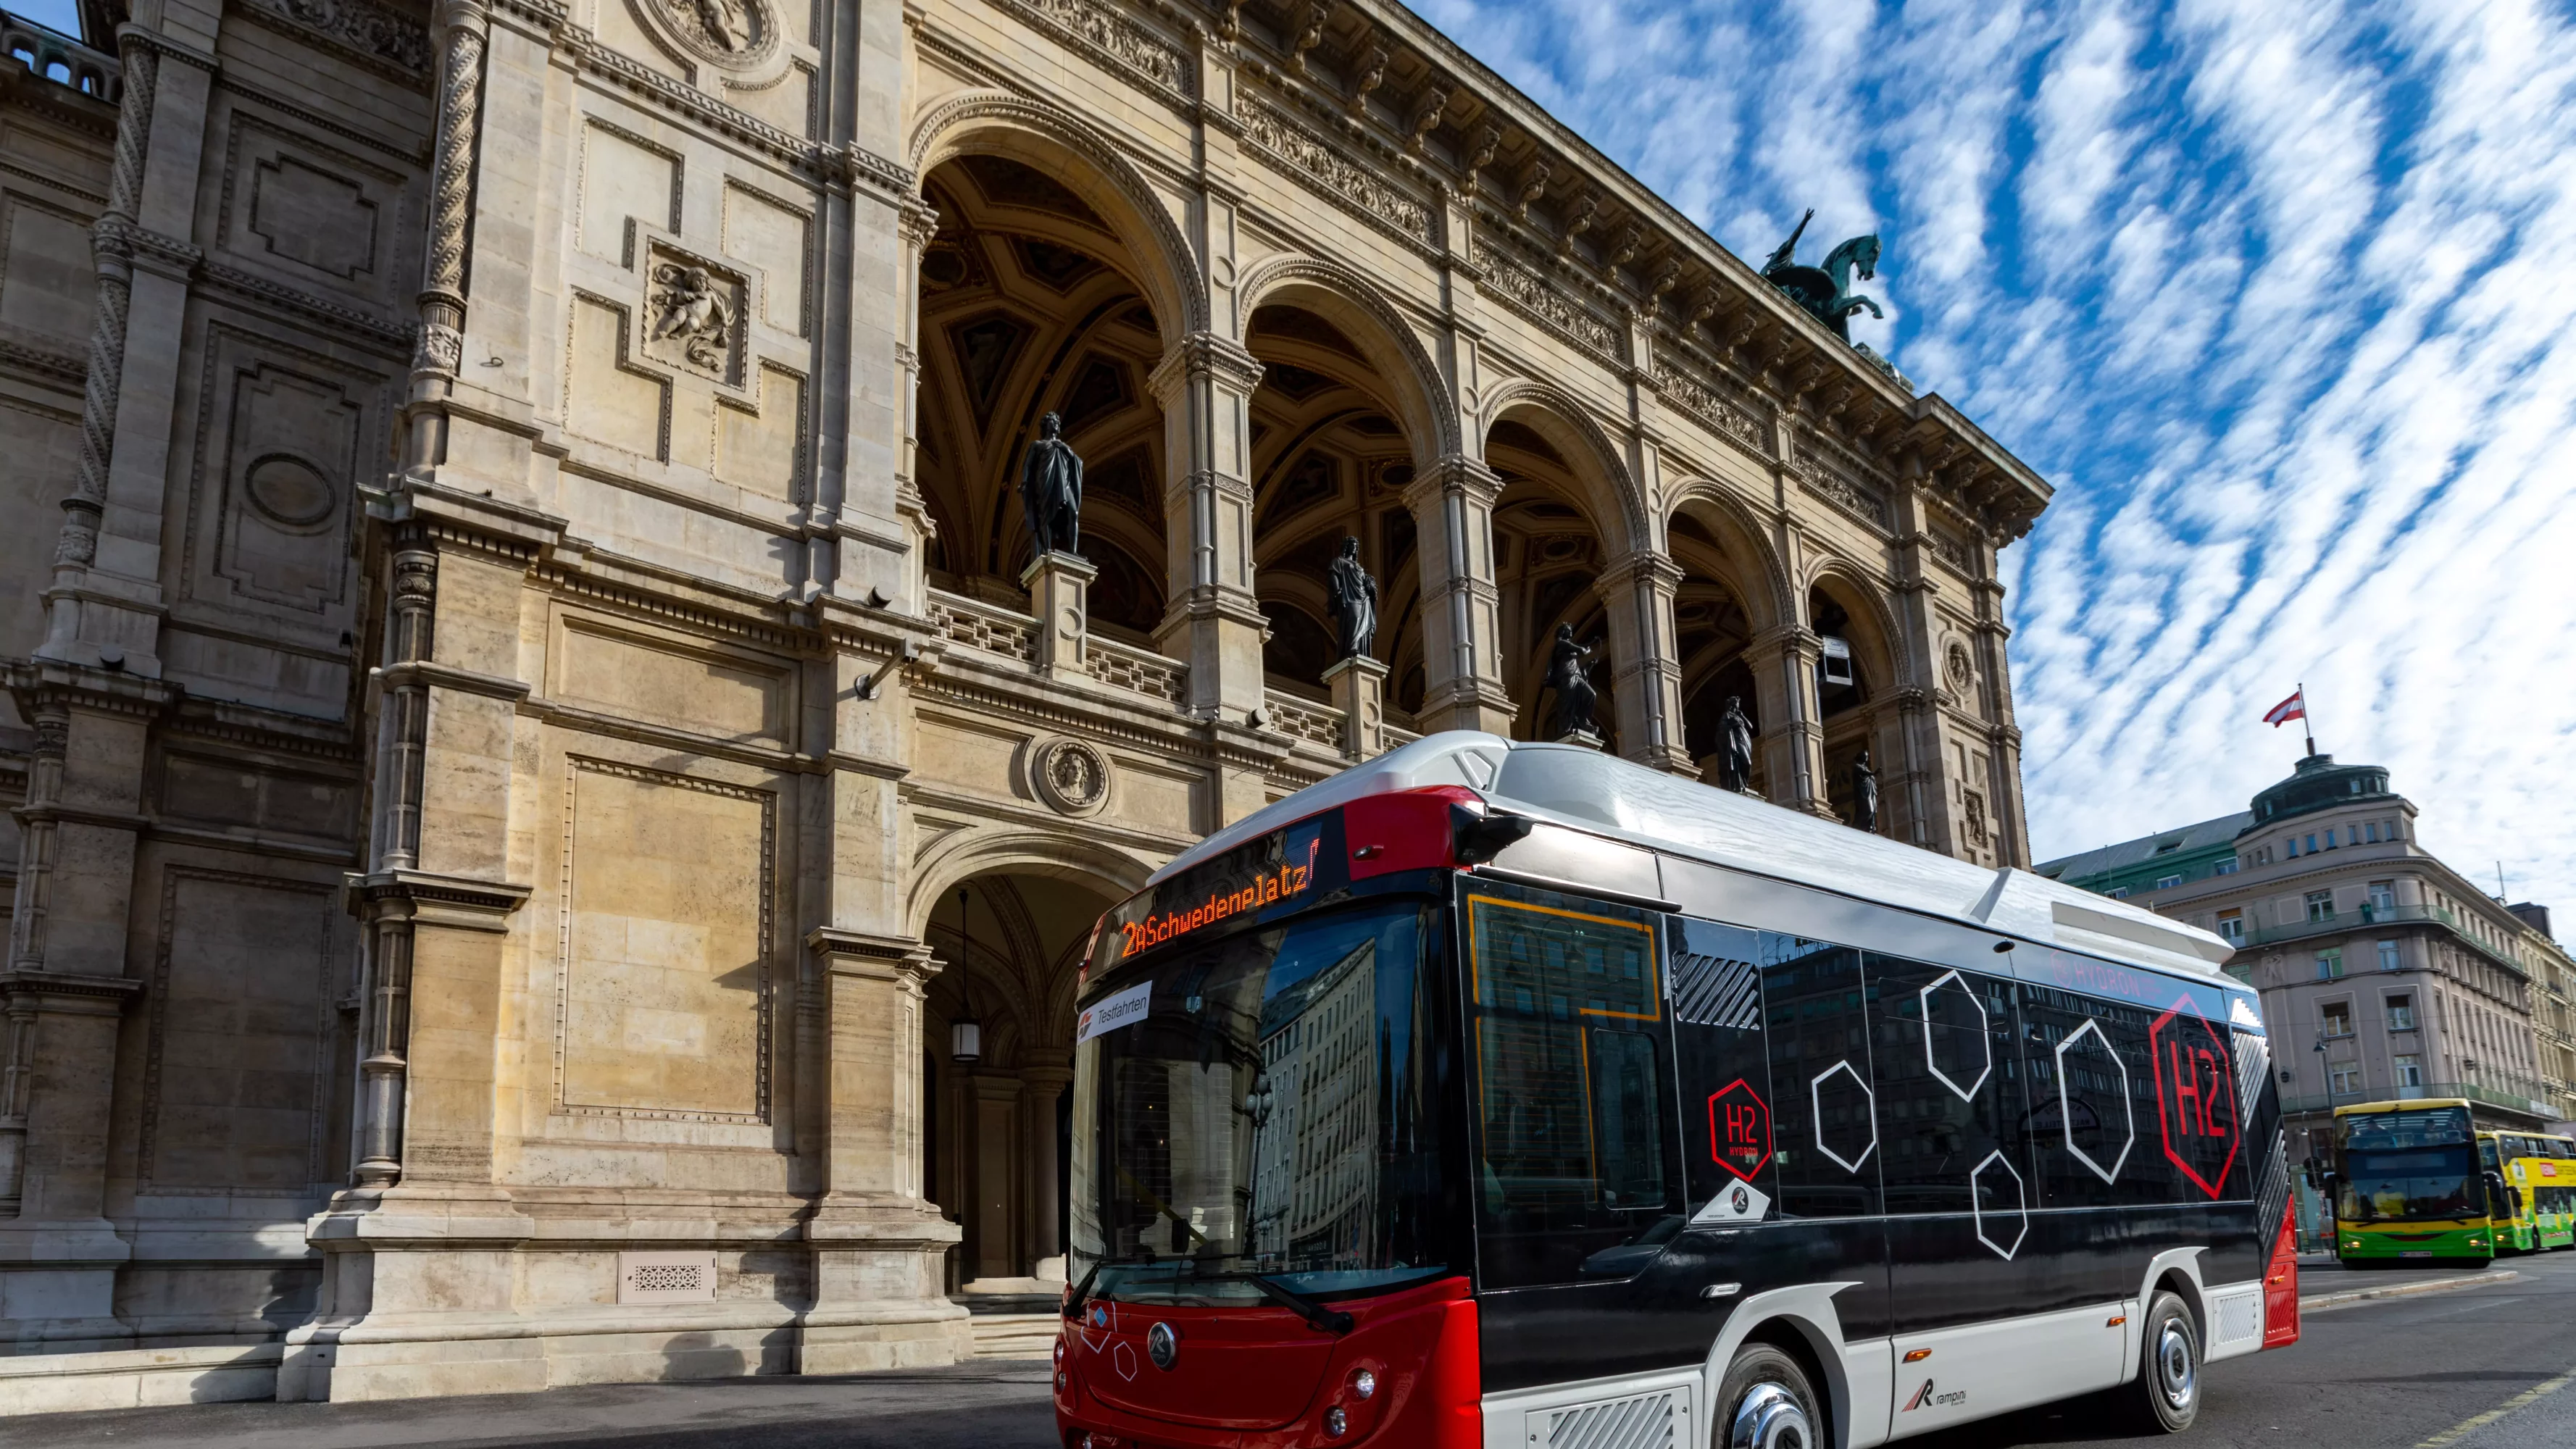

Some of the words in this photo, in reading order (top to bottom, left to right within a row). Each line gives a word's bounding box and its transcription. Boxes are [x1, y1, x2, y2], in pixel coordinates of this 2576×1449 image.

[1146, 865, 1307, 946] Schwedenplatz
[2074, 960, 2141, 998] HYDRON
[1098, 996, 1147, 1025] Testfahrten
[2169, 1040, 2225, 1137] H2
[1726, 1103, 1758, 1143] H2
[1729, 1146, 1758, 1157] HYDRON
[1936, 1390, 1967, 1406] rampini
